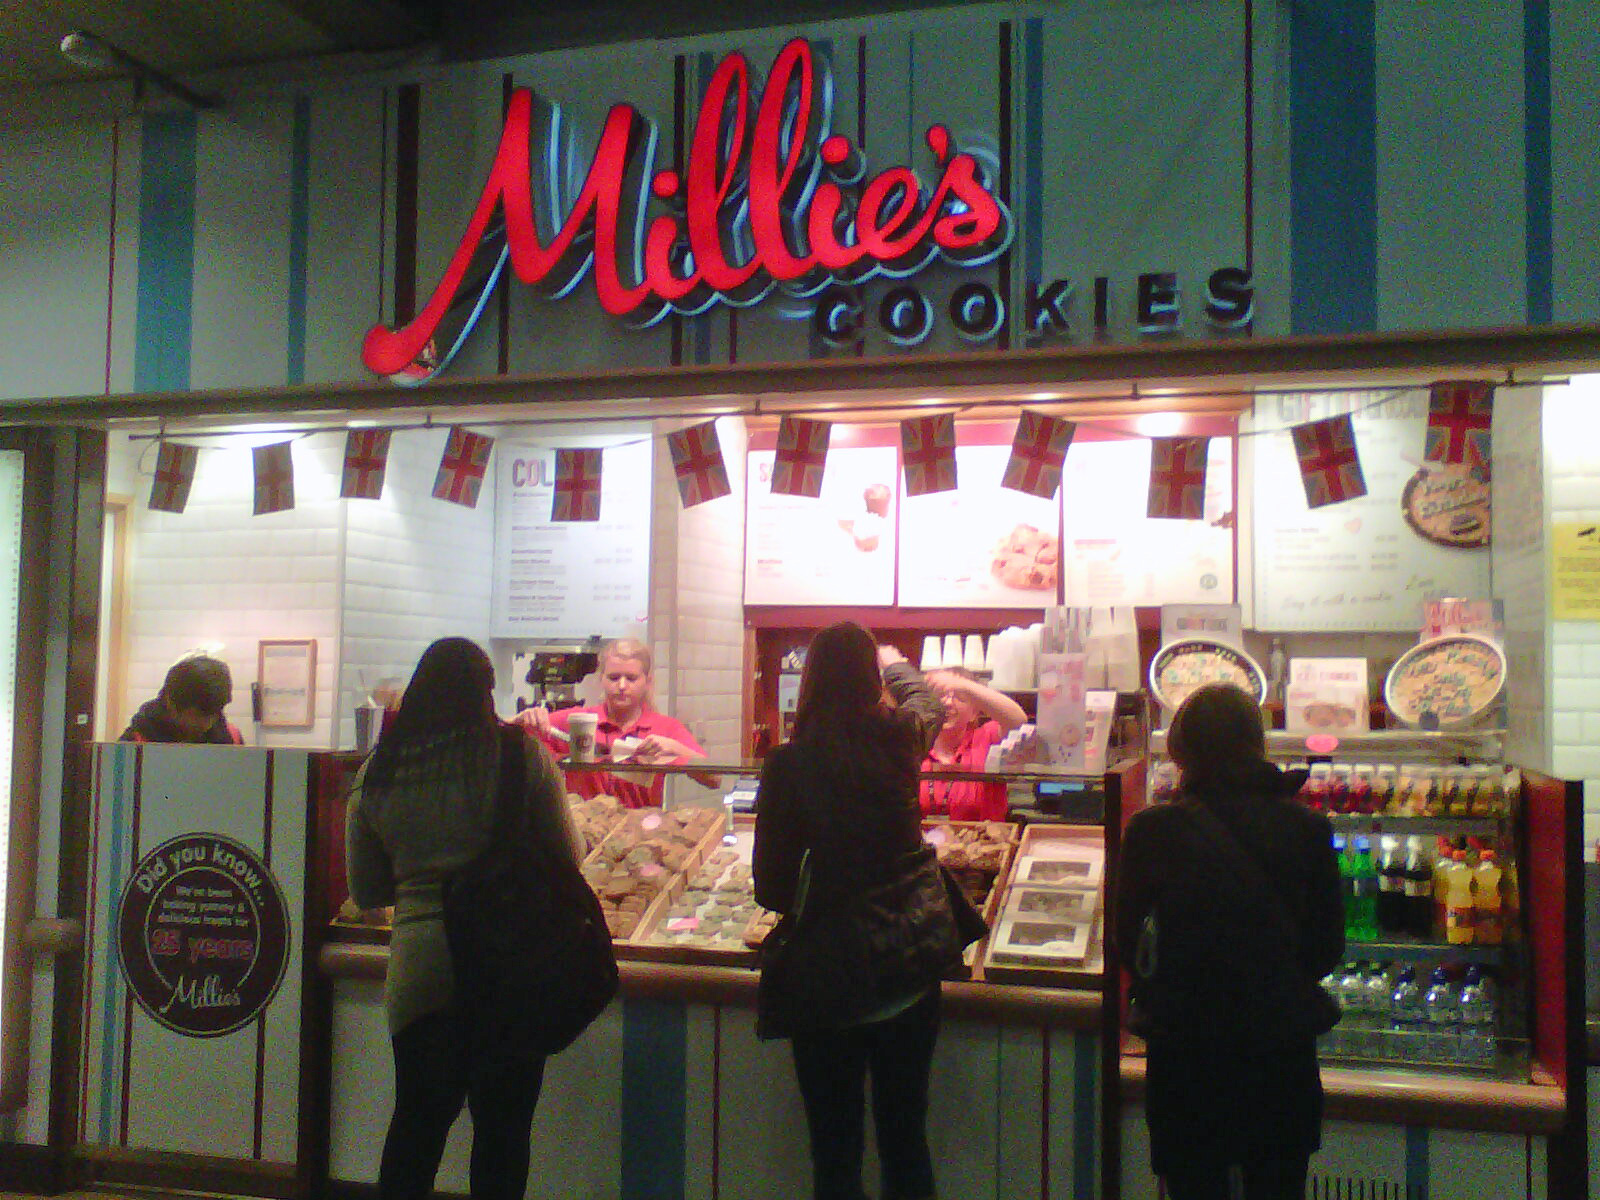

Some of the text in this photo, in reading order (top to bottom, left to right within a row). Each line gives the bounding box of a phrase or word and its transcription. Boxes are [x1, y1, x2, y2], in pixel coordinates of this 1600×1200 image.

[363, 37, 1003, 378] Millie's
[816, 267, 1254, 344] COOKIES
[512, 459, 554, 487] COL
[137, 855, 168, 893] Did
[170, 847, 206, 871] you
